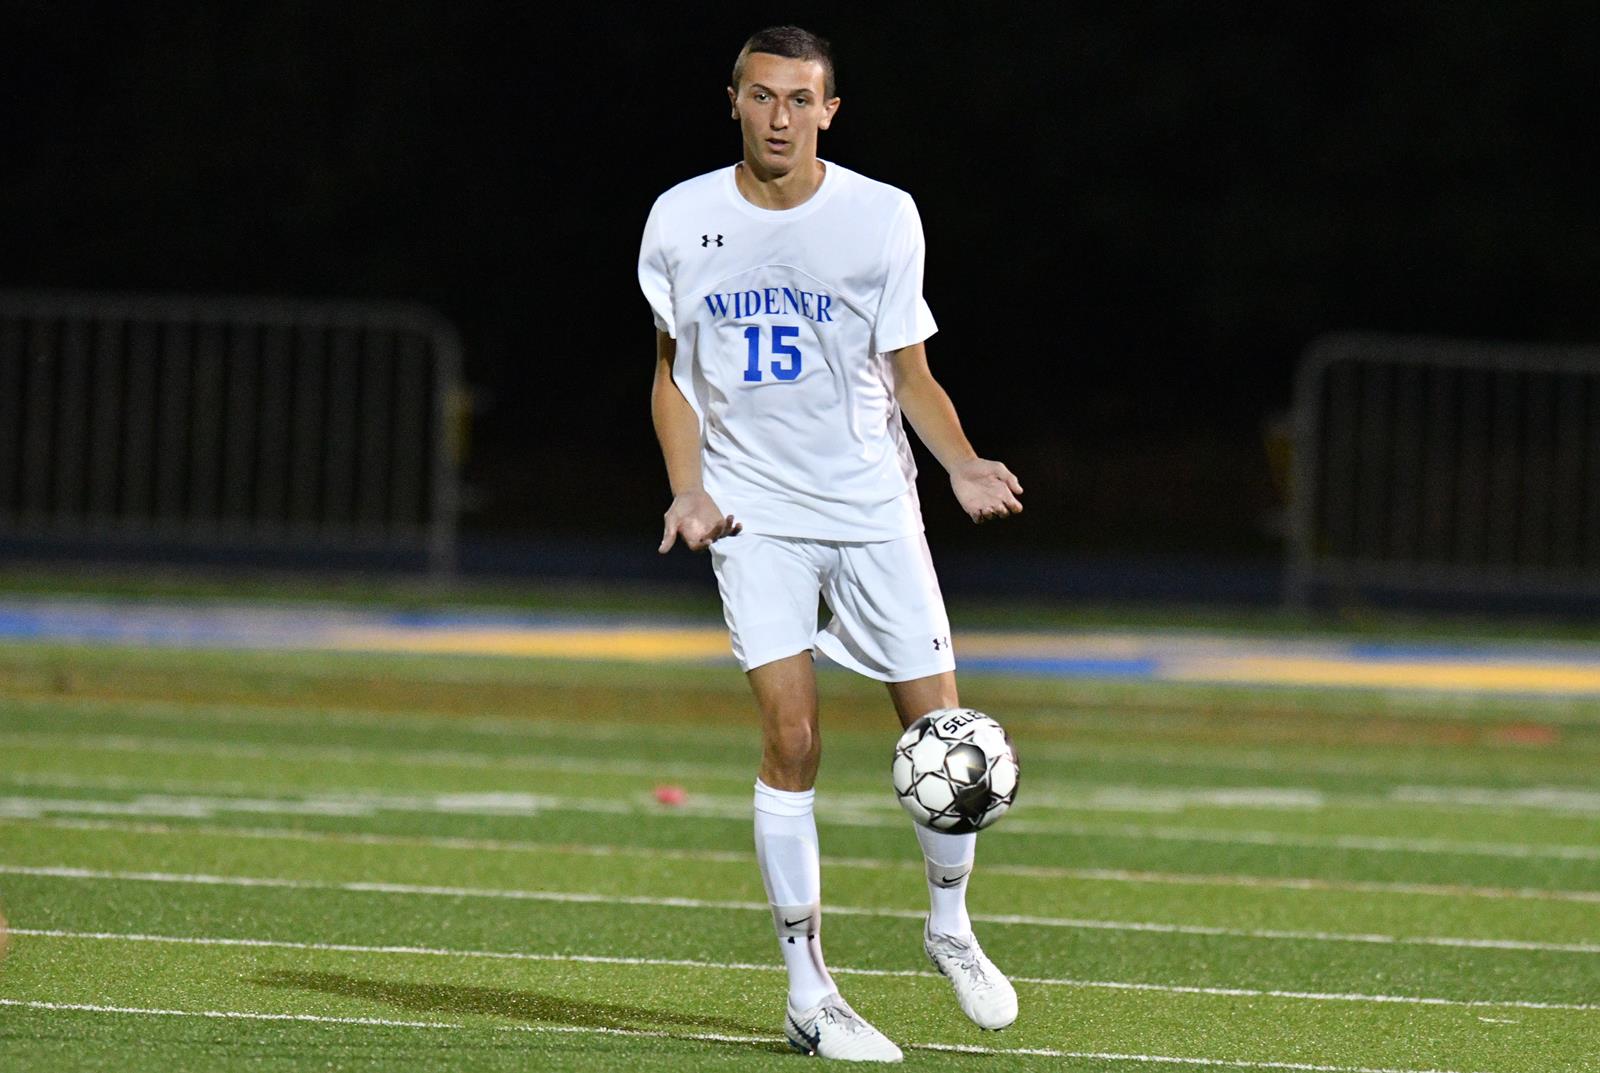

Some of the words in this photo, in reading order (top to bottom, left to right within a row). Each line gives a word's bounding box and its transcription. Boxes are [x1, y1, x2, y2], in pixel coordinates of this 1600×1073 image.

[704, 287, 833, 323] WIDENER
[743, 325, 802, 382] 15
[942, 711, 988, 734] SELE
